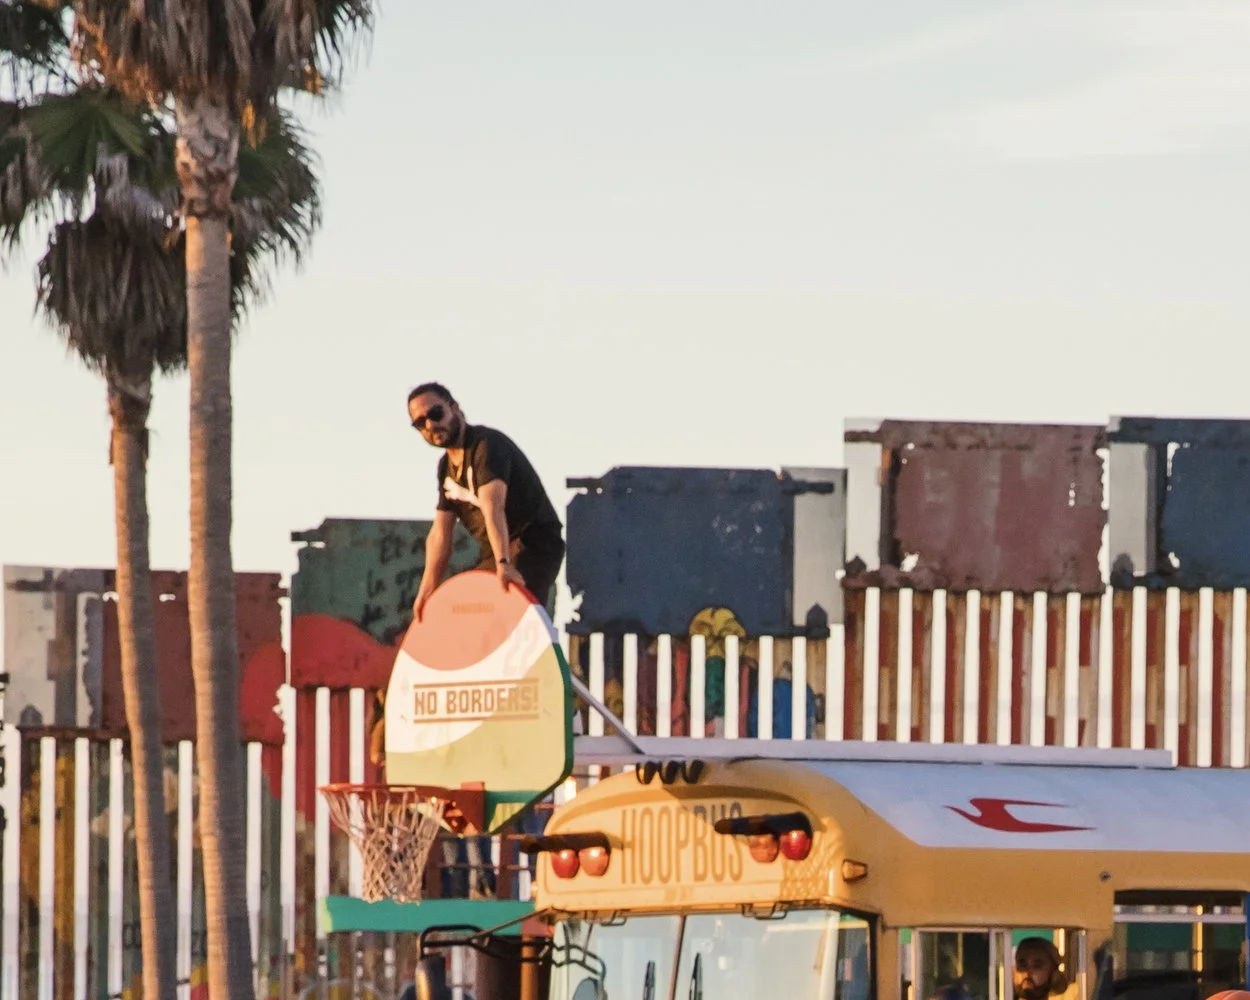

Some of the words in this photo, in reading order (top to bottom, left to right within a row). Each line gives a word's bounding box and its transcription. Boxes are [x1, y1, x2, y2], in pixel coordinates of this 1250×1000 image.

[413, 690, 438, 715] NO
[445, 685, 540, 714] BORDERS!
[621, 801, 744, 885] HOOPBUS
